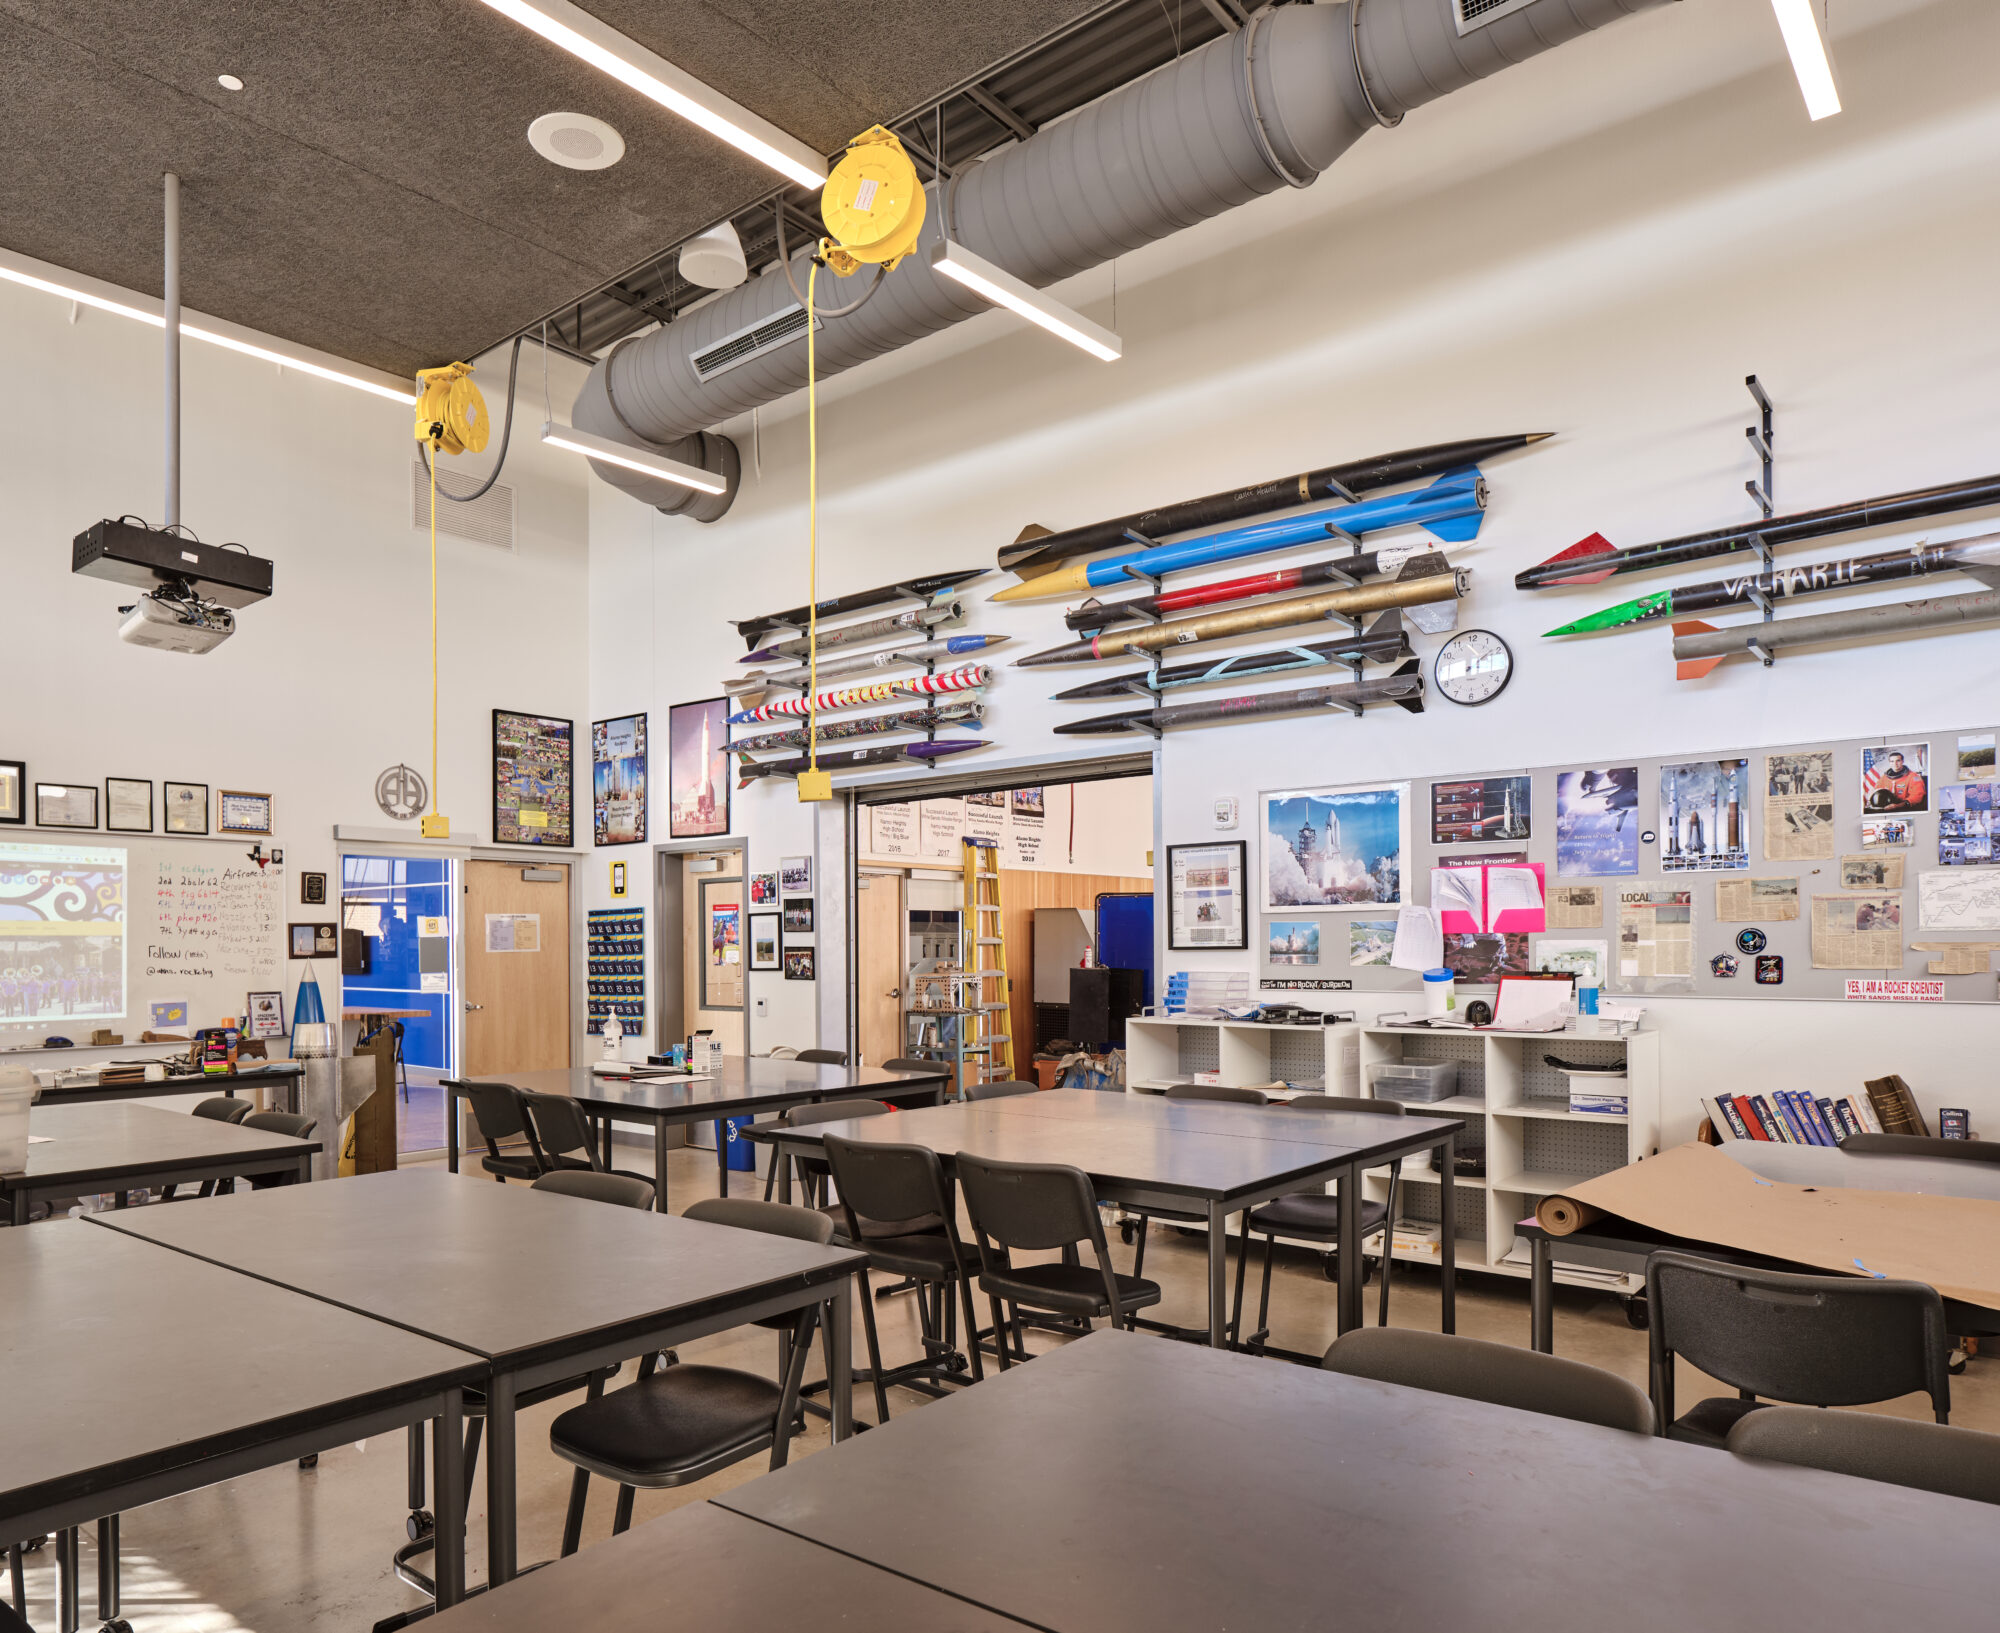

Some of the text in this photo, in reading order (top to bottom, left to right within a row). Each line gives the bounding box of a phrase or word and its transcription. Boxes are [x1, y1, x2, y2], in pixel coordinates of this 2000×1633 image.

[1468, 634, 1477, 642] 12
[1484, 688, 1489, 696] 5
[937, 849, 950, 857] 2017
[1621, 893, 1651, 903] LOCAL
[148, 945, 181, 959] Follow
[1847, 981, 1860, 994] YES,
[1866, 982, 1876, 993] AM
[1878, 982, 1883, 993] A
[1884, 982, 1909, 994] ROCKET
[1910, 982, 1943, 995] SCIENTIST
[1723, 1101, 1745, 1137] Dictionary
[1823, 1105, 1845, 1142] Dictionary
